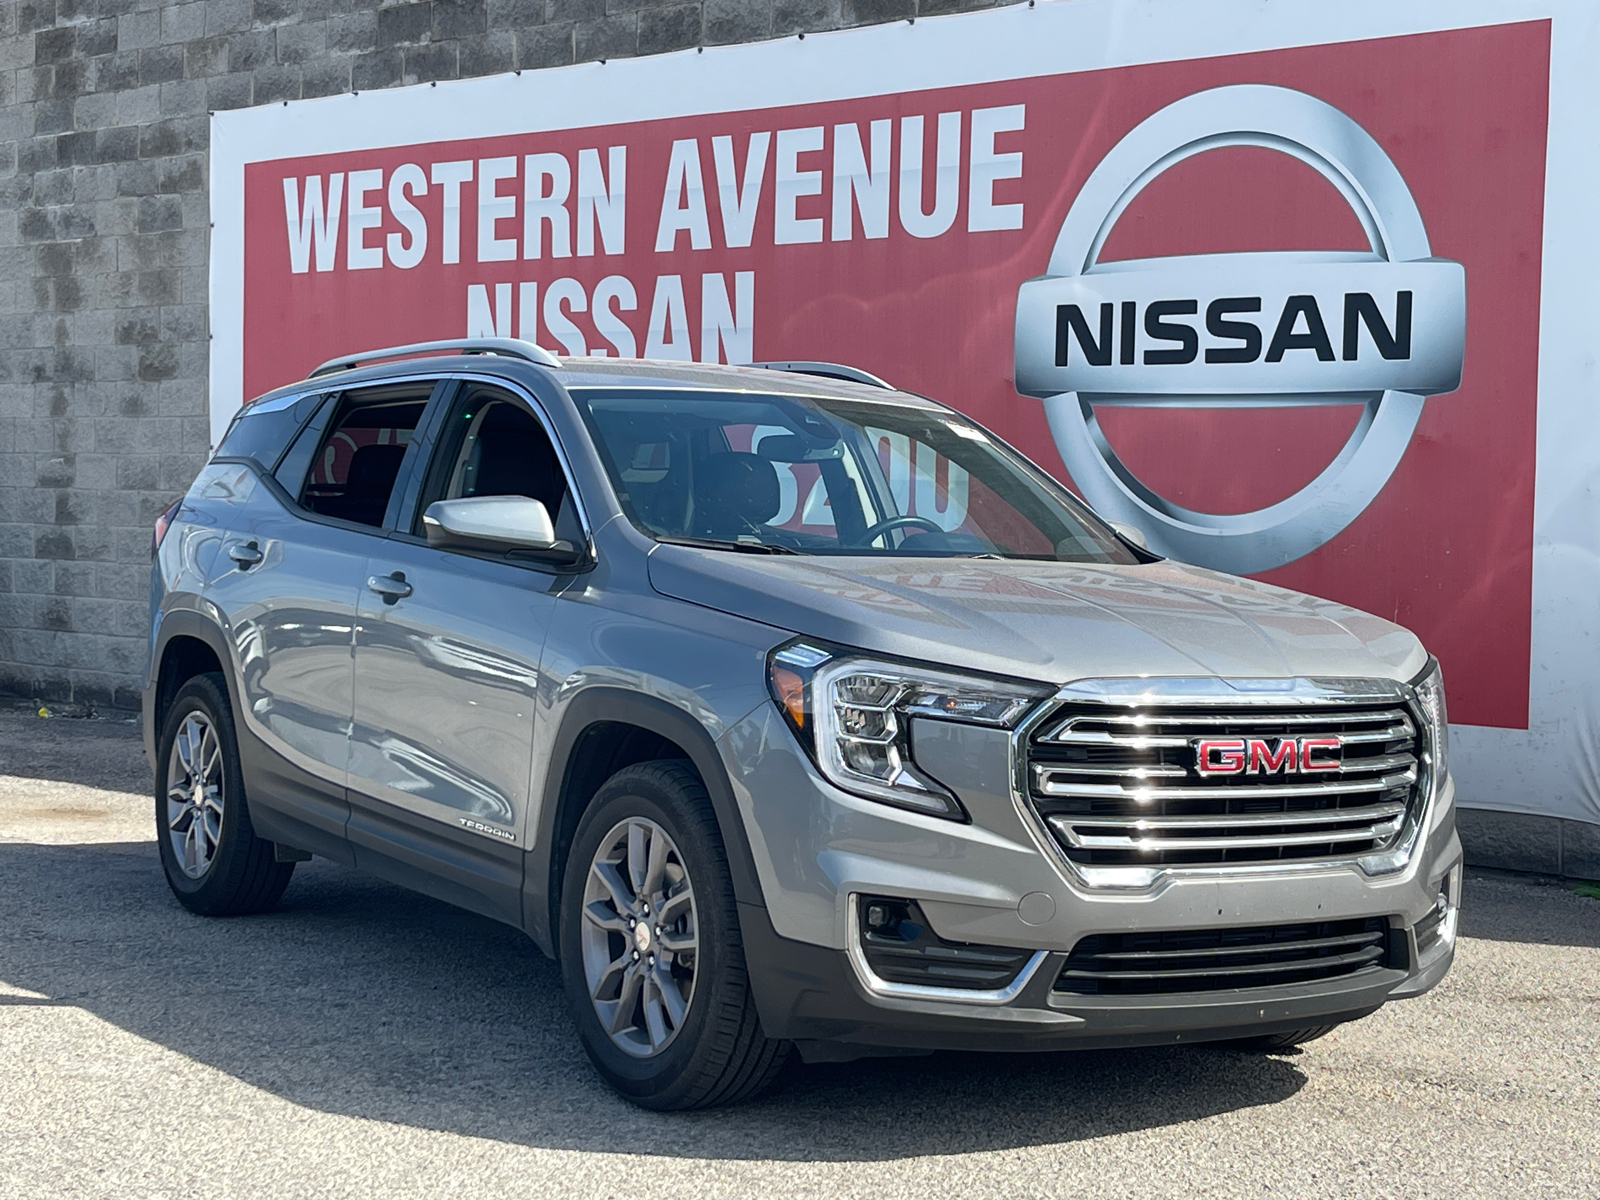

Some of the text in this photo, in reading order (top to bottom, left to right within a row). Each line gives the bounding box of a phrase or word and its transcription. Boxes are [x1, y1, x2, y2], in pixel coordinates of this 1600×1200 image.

[283, 104, 1026, 274] WESTERN AVENUE
[467, 271, 755, 364] NISSAN
[1055, 290, 1413, 367] NISSAN
[1195, 737, 1341, 777] GMC
